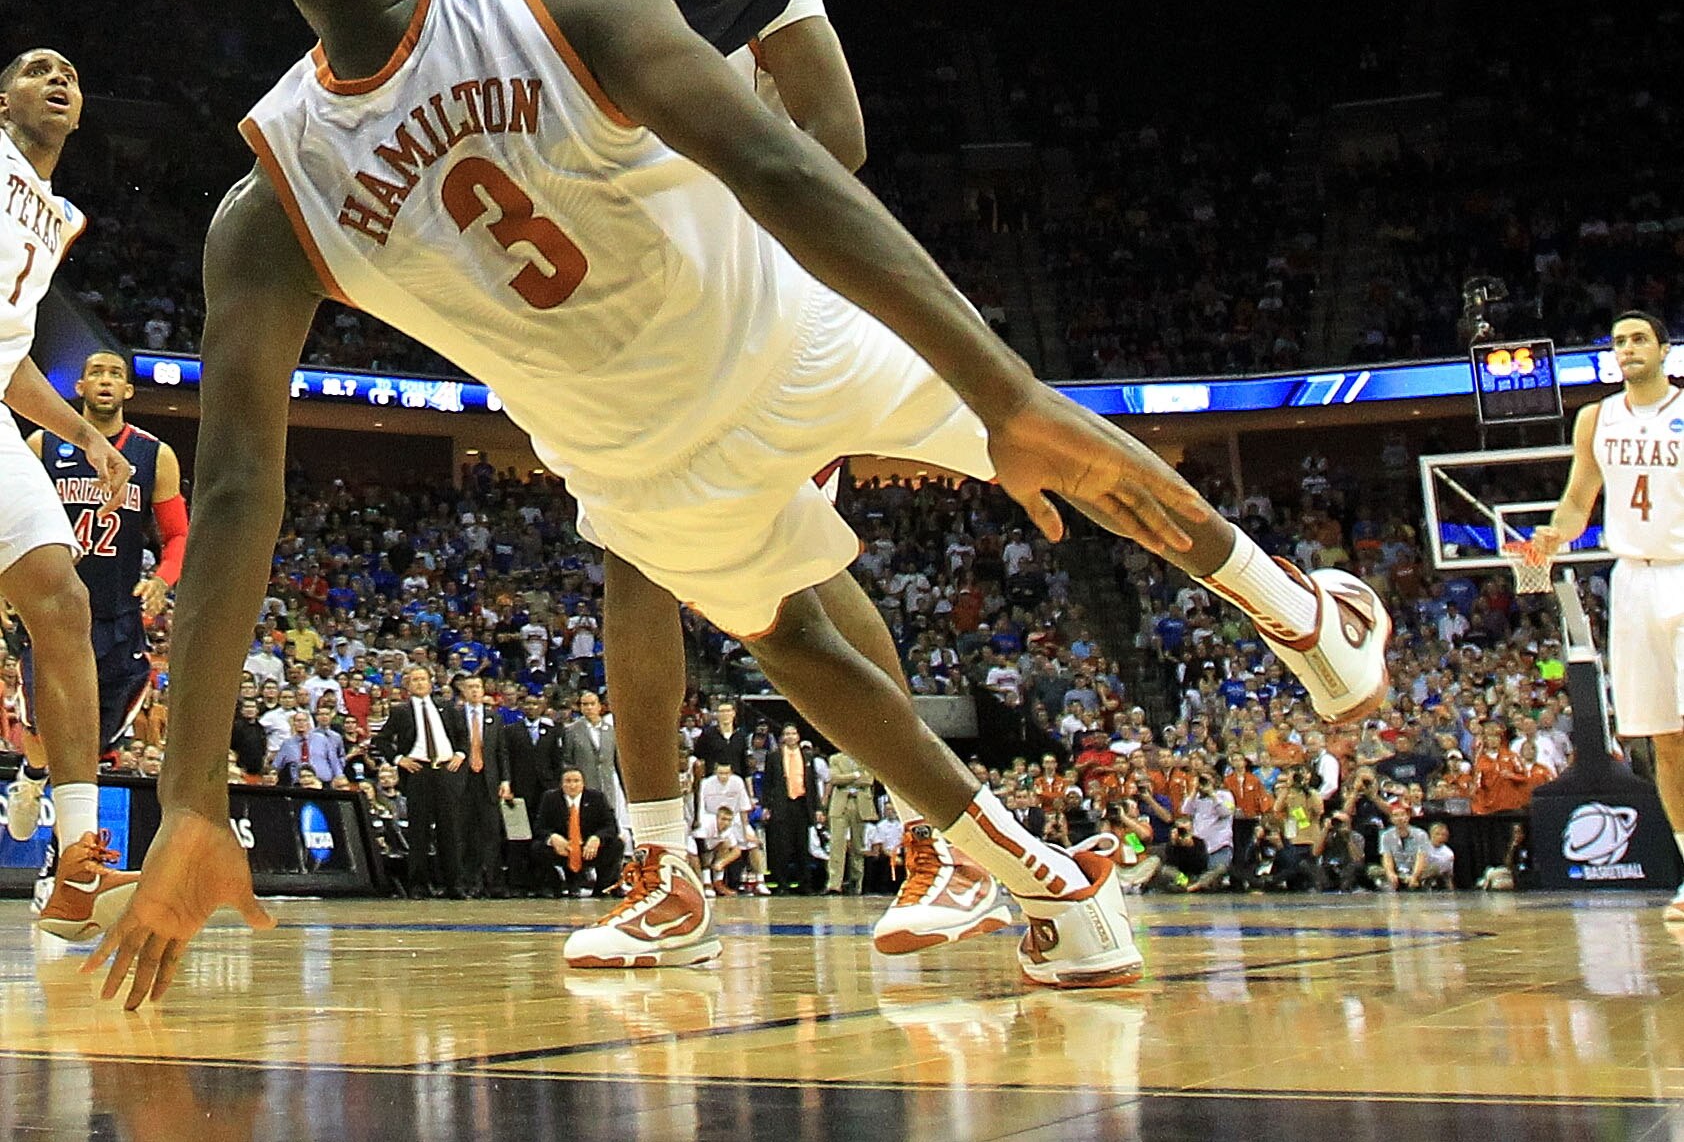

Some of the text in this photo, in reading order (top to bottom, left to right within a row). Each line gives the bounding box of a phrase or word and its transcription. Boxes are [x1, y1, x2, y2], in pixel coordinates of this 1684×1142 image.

[338, 77, 542, 247] HAMILTON
[6, 173, 63, 256] TEXAS
[441, 157, 588, 310] 3
[8, 242, 36, 306] 1
[1604, 439, 1680, 467] TEXAS
[1631, 474, 1652, 522] 4
[74, 508, 121, 556] 42
